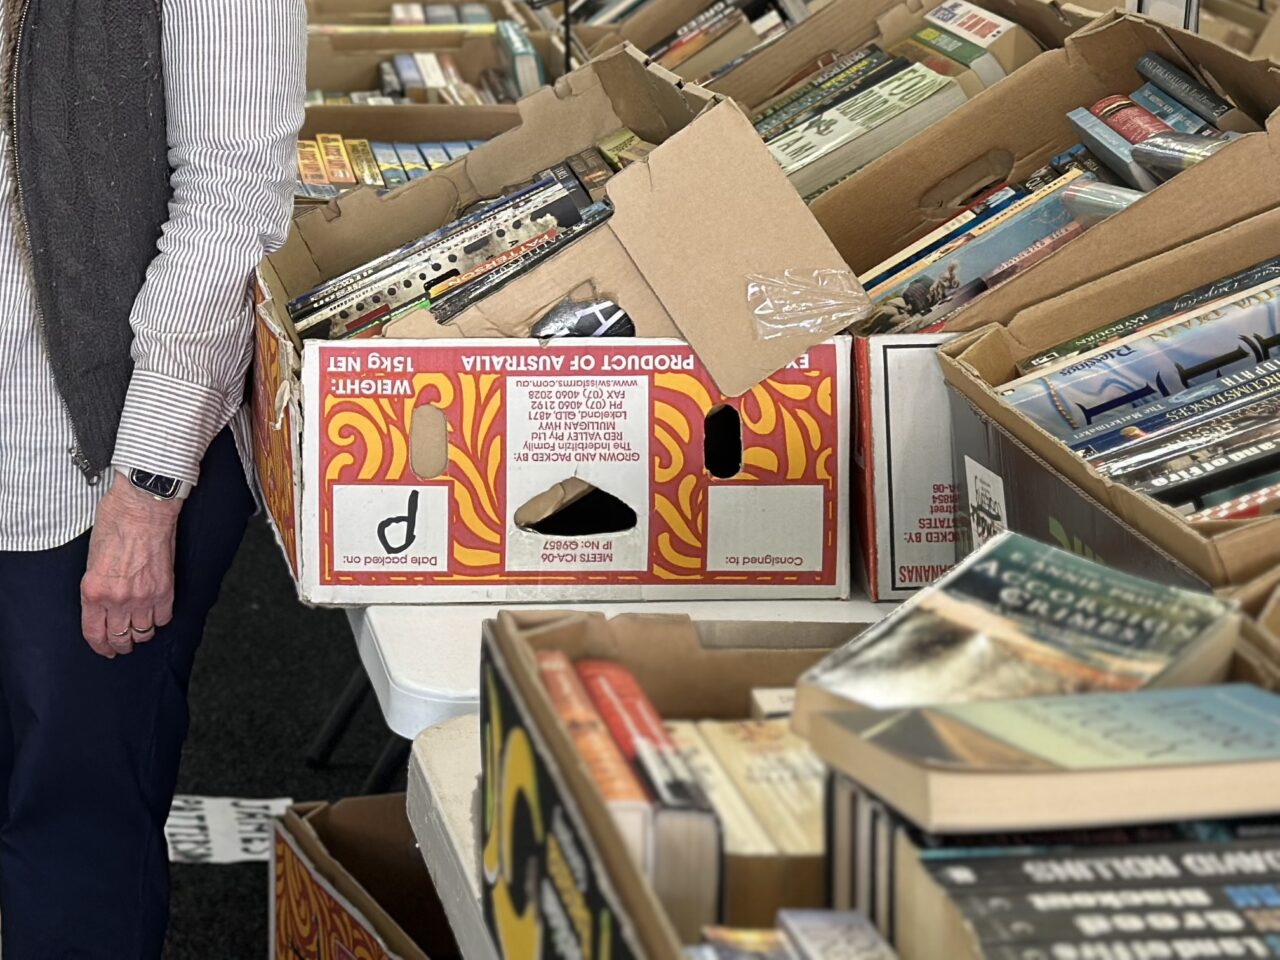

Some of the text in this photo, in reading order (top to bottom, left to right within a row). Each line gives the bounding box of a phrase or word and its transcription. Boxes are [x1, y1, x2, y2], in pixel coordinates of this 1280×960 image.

[447, 233, 550, 288] PATTERSON
[1075, 314, 1149, 347] RAYBOURN
[327, 352, 413, 371] 15kg NET
[461, 354, 565, 371] AUSTRALIA
[570, 355, 595, 370] OF
[601, 354, 694, 370] PRODUCT
[1058, 342, 1137, 380] Blessings
[331, 379, 411, 394] WEIGHT:
[528, 389, 625, 399] FAX (07) 4060 2028
[531, 399, 622, 409] PH (07) 4060 2192
[528, 411, 551, 420] 4871
[578, 410, 627, 419] Lakeland,
[538, 422, 615, 430] MULLIGAN HWY
[531, 431, 622, 440] RED VALLEY Pty Ltd
[523, 441, 555, 451] Family
[514, 453, 640, 461] GROWN AND PACKED BY:
[1150, 465, 1199, 491] Fire
[904, 532, 921, 543] BY:
[543, 541, 612, 549] IP No: Q9857
[343, 555, 437, 565] Date packed on:
[541, 553, 613, 562] MEETS ICA-06
[726, 555, 803, 566] Consigned to:
[973, 559, 1200, 639] ACCORDION
[999, 586, 1139, 641] CRIMES
[1023, 855, 1179, 883] ROLLINS
